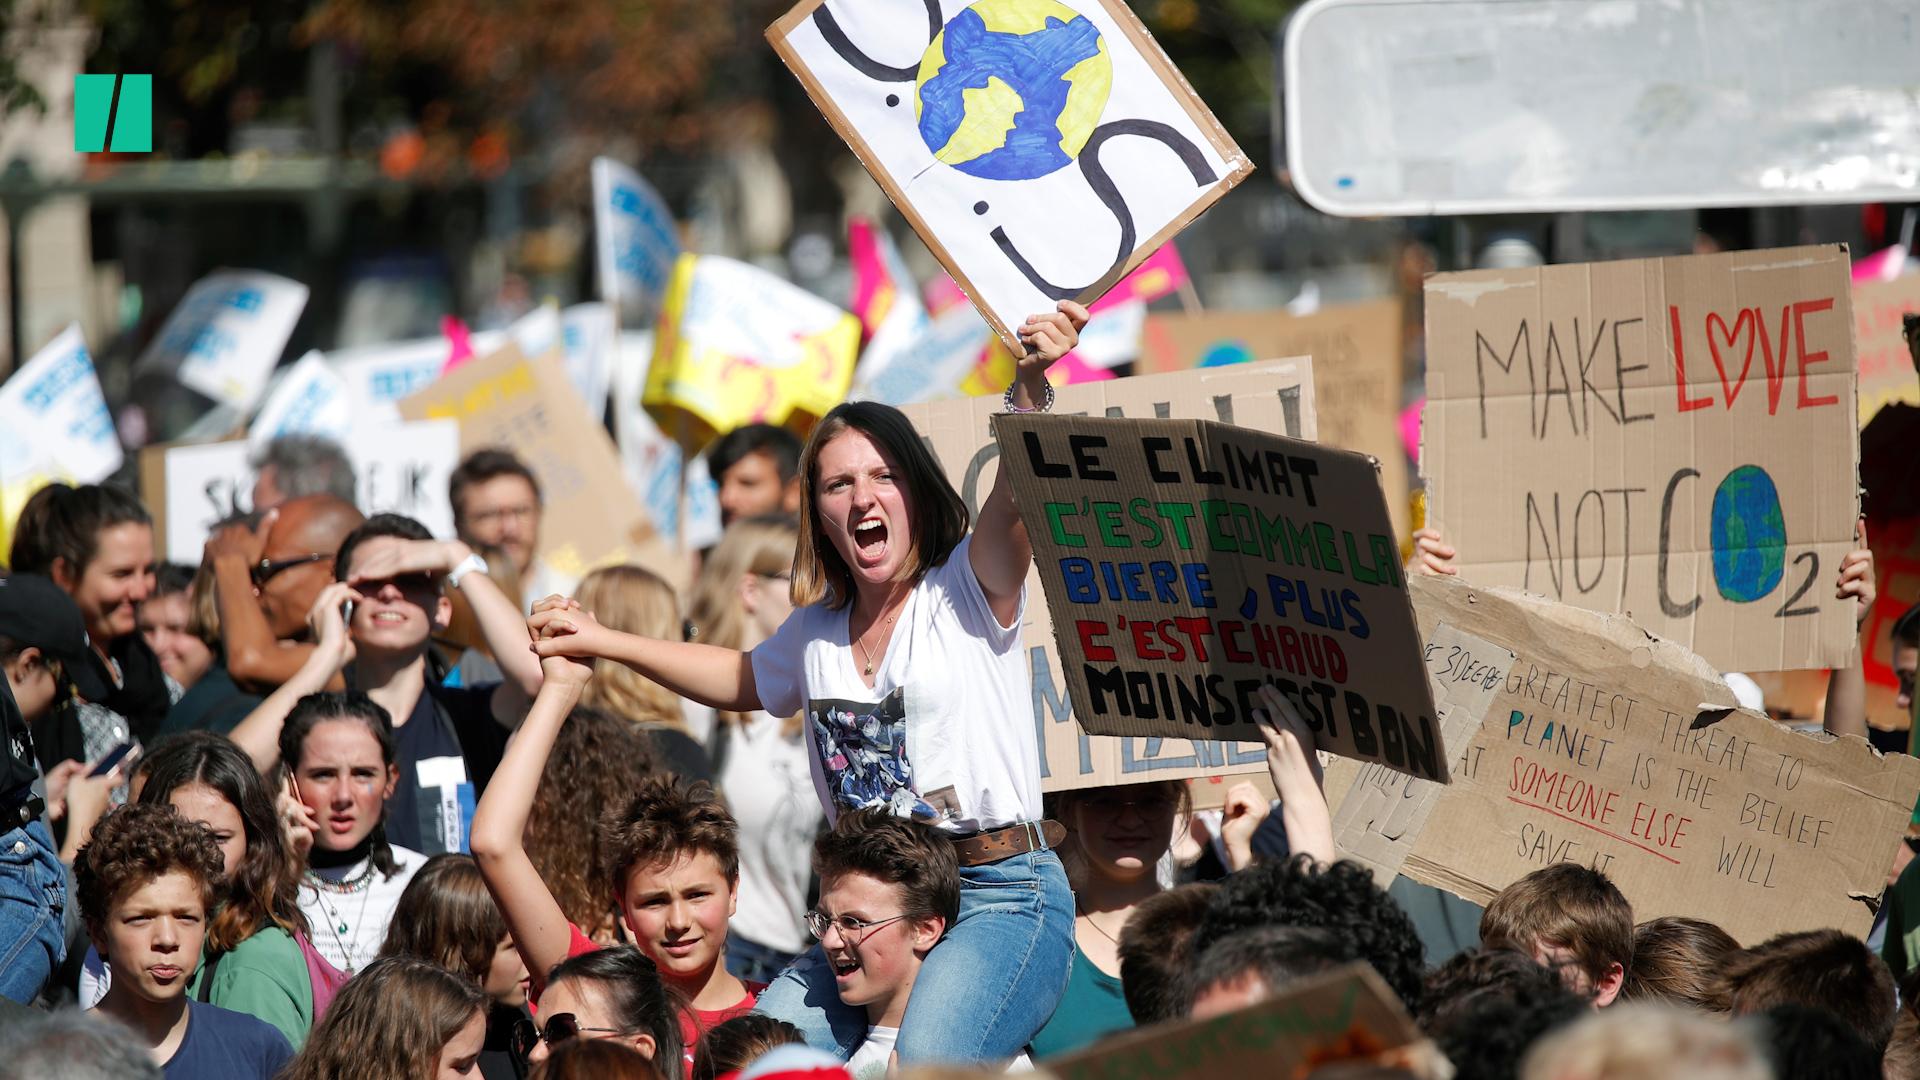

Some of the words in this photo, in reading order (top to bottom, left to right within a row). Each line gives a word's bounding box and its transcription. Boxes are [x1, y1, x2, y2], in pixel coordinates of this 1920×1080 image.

[1475, 317, 1655, 440] MAKE
[1669, 297, 1839, 415] LOVE
[1022, 431, 1118, 481] LE
[1141, 437, 1319, 507] CLIMAT
[1043, 496, 1196, 549] C'EST
[1200, 499, 1344, 574] COMME
[1343, 530, 1399, 588] LA
[1059, 557, 1218, 609] BIERE
[1266, 573, 1371, 639] PLUS
[1523, 487, 1647, 602] NOT
[1075, 614, 1215, 663] C'EST
[1217, 619, 1348, 684] CHAUD
[1083, 663, 1236, 728] MOINS
[1344, 690, 1438, 780] BON
[1505, 663, 1640, 732] GREATEST
[1657, 707, 1758, 774] THREAT
[1776, 752, 1804, 791] TO
[1507, 710, 1616, 771] PLANET
[1631, 752, 1656, 791] IS
[1676, 767, 1718, 810] THE
[1739, 792, 1833, 848] BELIEF
[1509, 756, 1621, 825] SOMEONE
[1631, 801, 1693, 849] ELSE
[1718, 835, 1776, 889] WILL
[1517, 822, 1582, 865] SAVE
